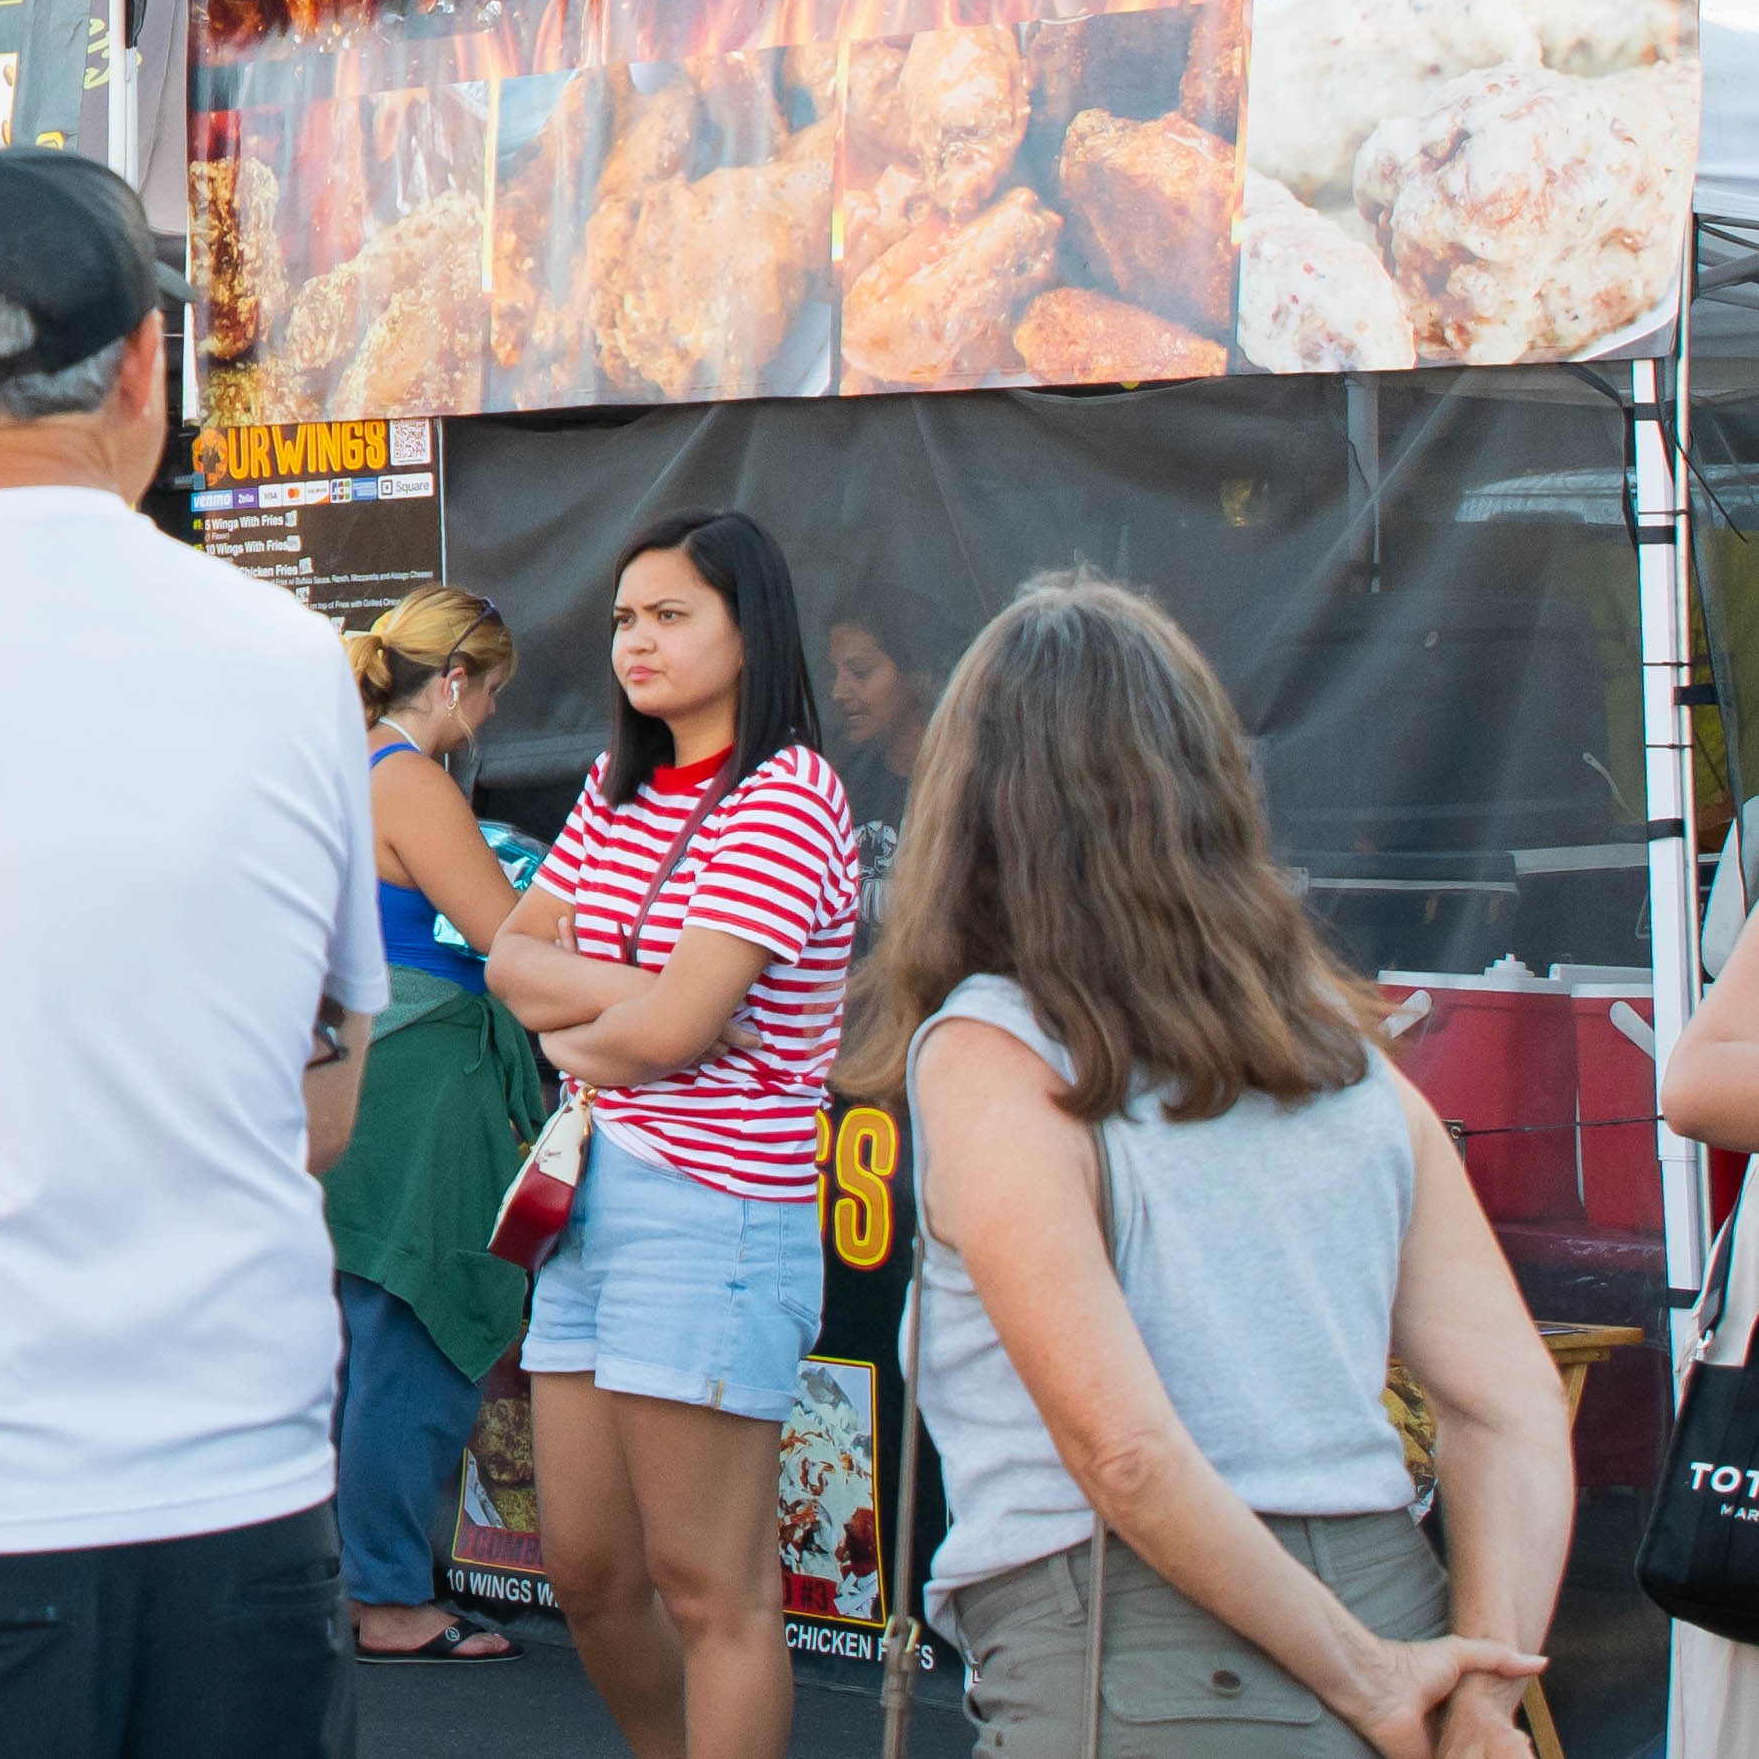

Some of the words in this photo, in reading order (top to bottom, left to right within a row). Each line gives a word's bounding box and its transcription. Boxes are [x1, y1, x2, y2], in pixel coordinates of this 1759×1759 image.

[271, 420, 387, 477] WINGS
[395, 478, 431, 494] Square
[211, 516, 239, 532] Wings
[239, 515, 260, 528] With
[261, 513, 284, 527] Fries
[216, 541, 244, 557] Wings
[244, 540, 265, 553] With
[275, 563, 298, 577] Fries
[446, 1568, 465, 1593] 10
[468, 1570, 533, 1604] WINGS
[785, 1622, 872, 1660] CHICKEN
